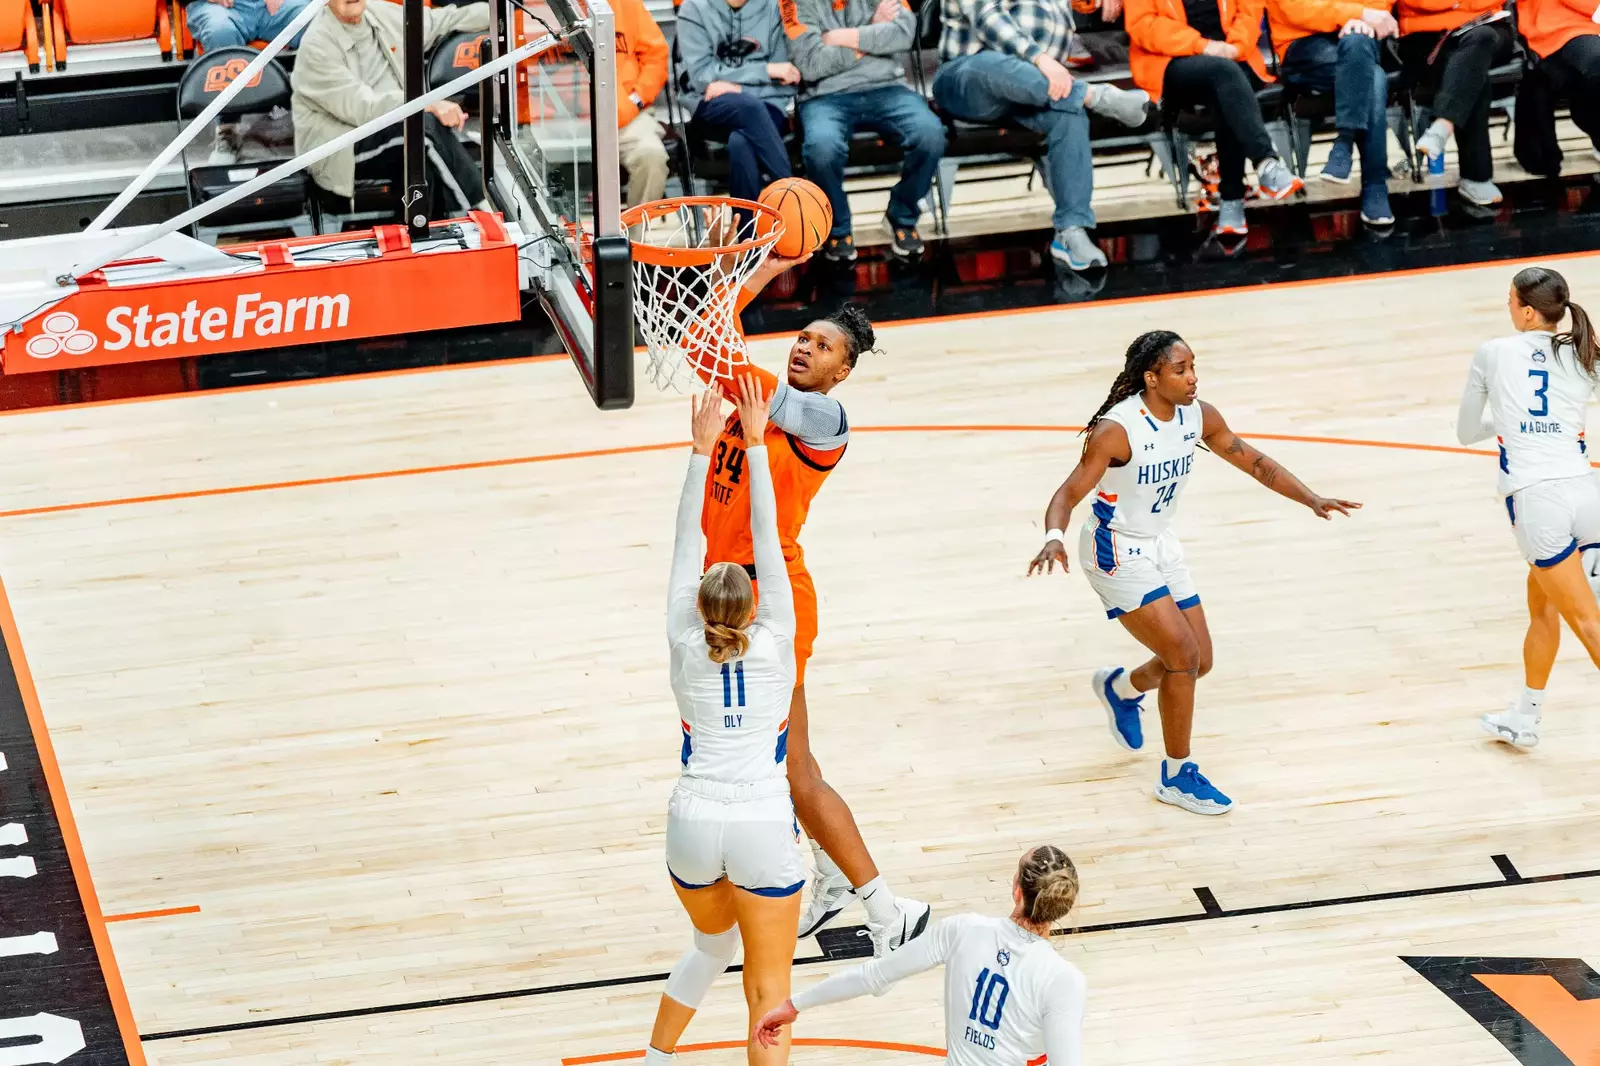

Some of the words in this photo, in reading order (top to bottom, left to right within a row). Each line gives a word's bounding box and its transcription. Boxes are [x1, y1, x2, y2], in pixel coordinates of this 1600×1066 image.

[1528, 369, 1549, 417] 3
[715, 440, 746, 484] 34
[1151, 481, 1178, 514] 24
[720, 660, 746, 708] 11
[724, 714, 743, 728] OLY
[969, 967, 1010, 1031] 10
[964, 1026, 996, 1051] FIELDS
